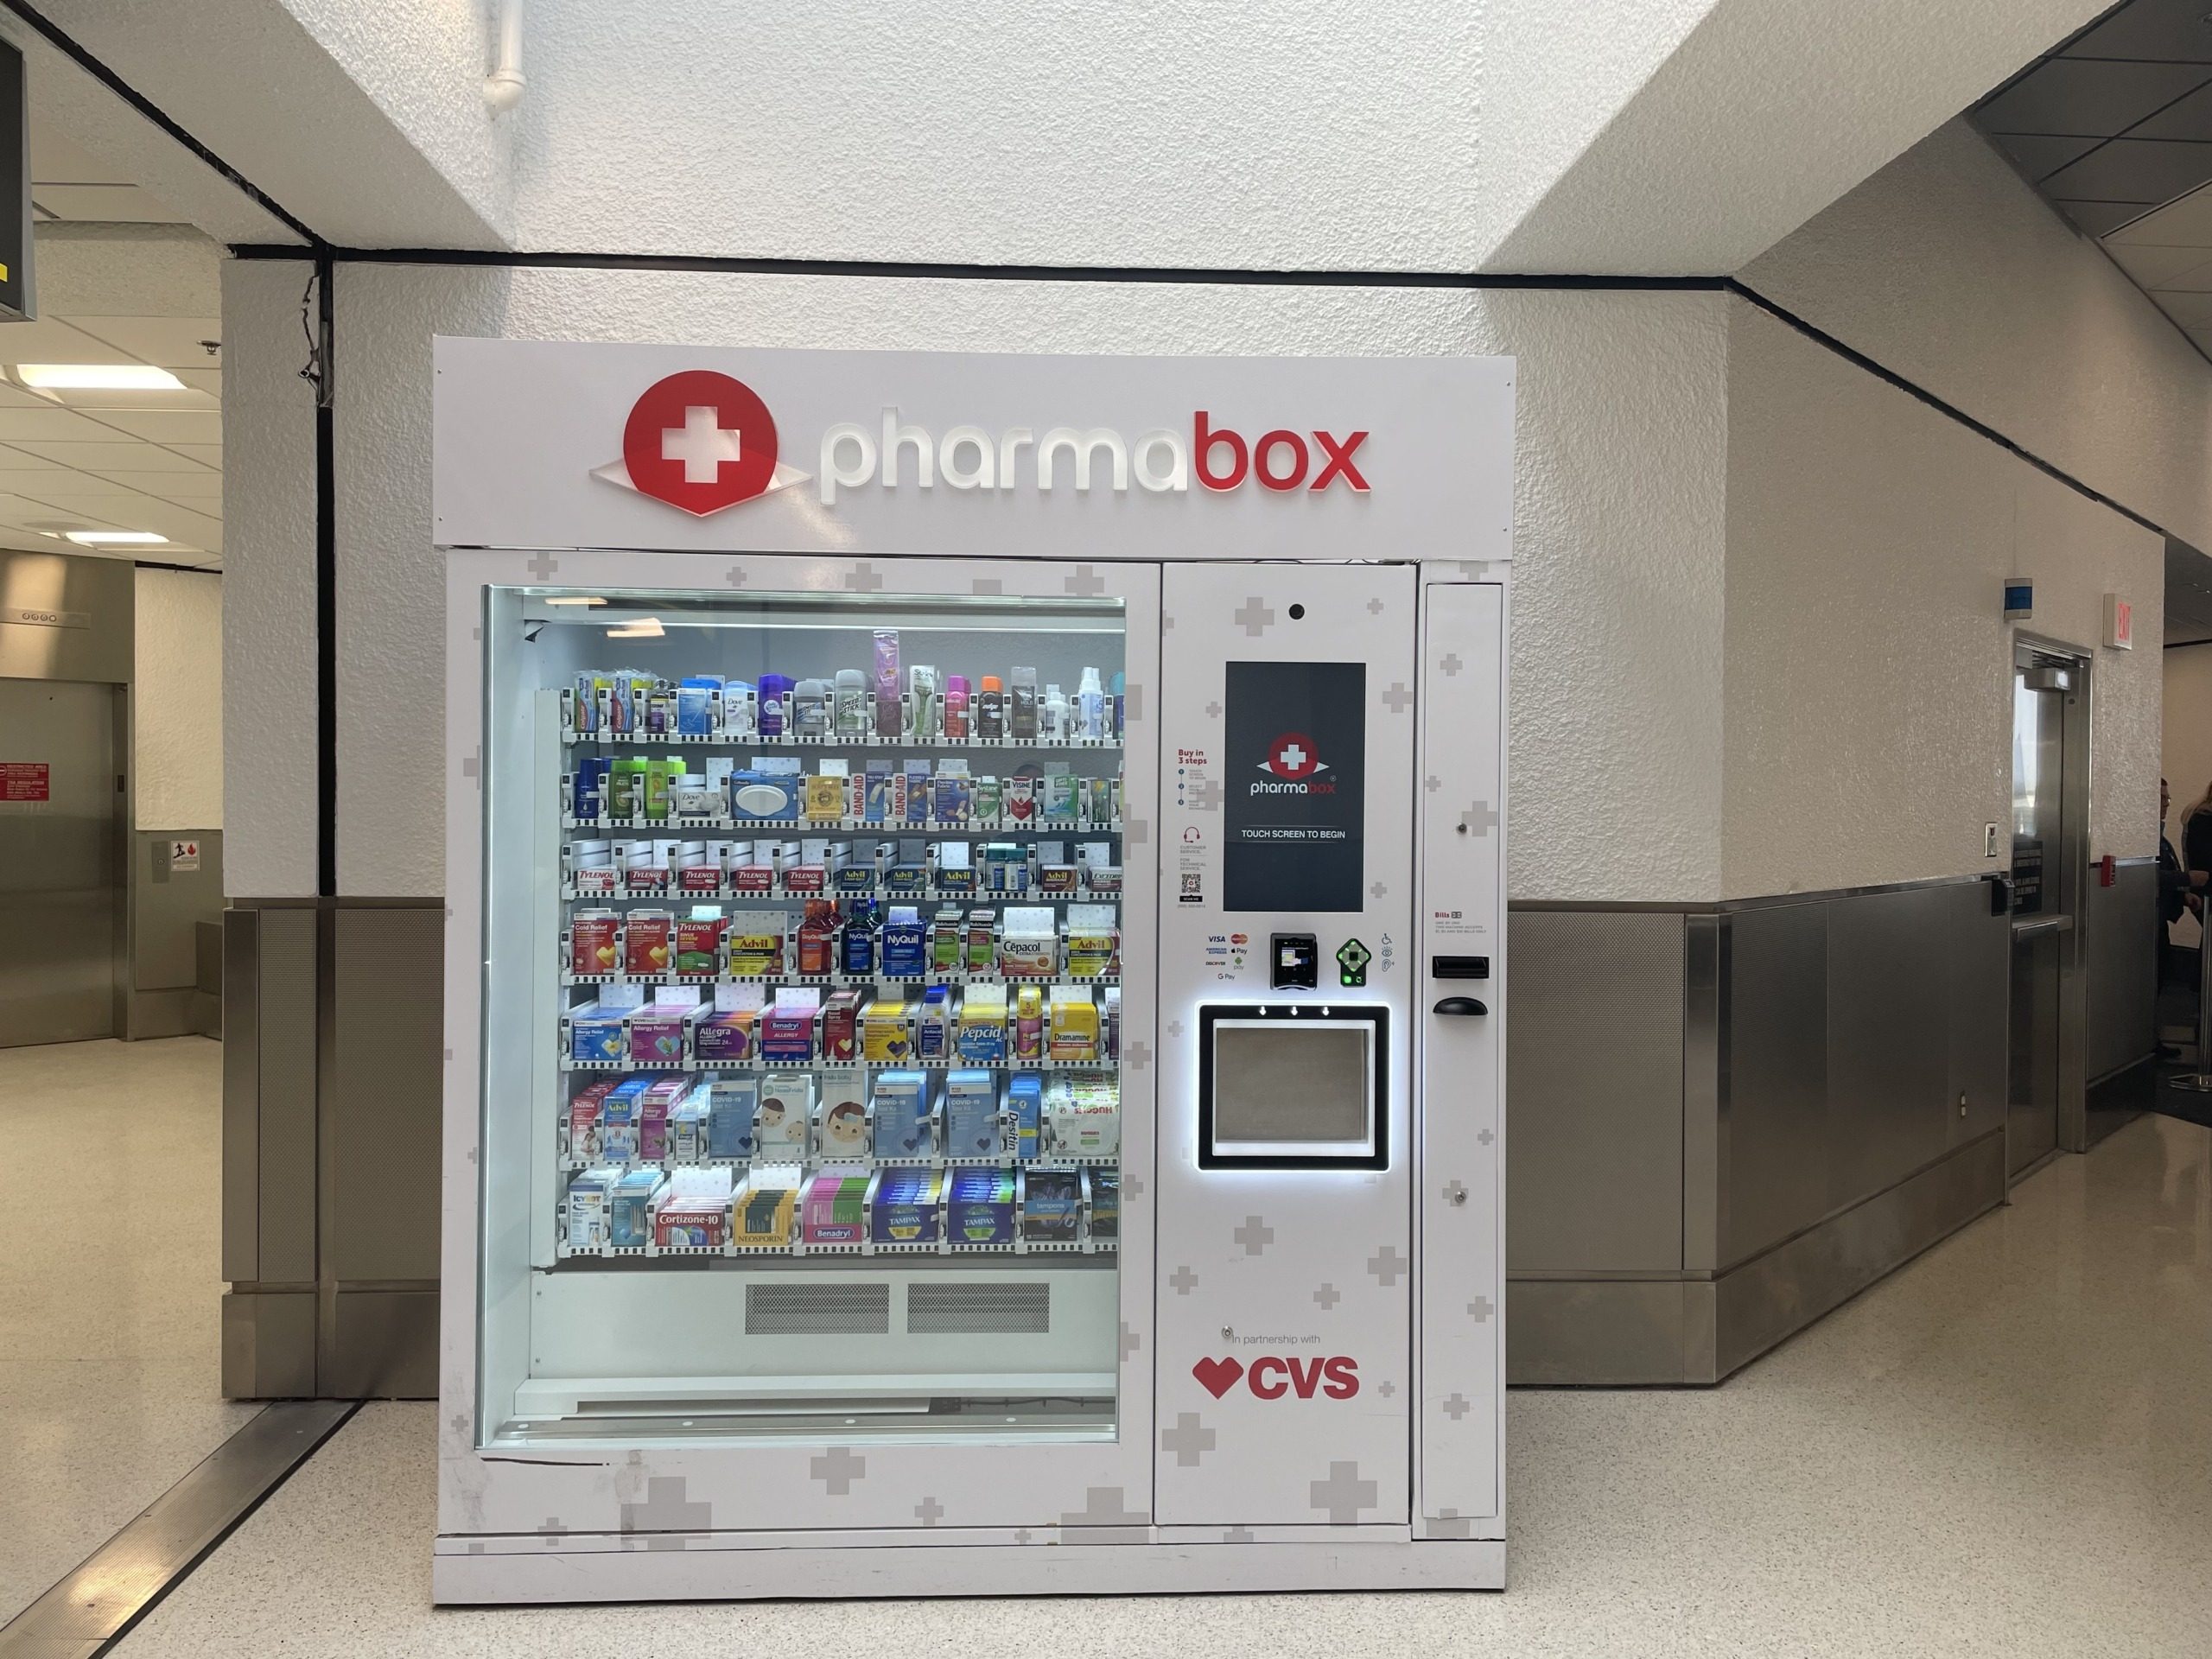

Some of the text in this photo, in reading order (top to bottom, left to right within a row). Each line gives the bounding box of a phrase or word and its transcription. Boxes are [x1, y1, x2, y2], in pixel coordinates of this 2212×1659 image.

[820, 406, 1372, 505] pharmabox
[1250, 780, 1336, 796] pharmabox
[854, 775, 864, 816] BAND-AID
[895, 775, 906, 816] BAND-AID
[1272, 830, 1305, 838] SCREEN
[1320, 830, 1345, 839] BEGIN
[579, 870, 614, 879] TYLENOL
[740, 939, 768, 948] Advil
[887, 934, 919, 946] NyQuil
[1077, 940, 1105, 949] Advil
[700, 1027, 731, 1036] Allegra
[960, 1026, 1002, 1042] Pepcid
[1054, 1033, 1090, 1041] Dramamine
[1008, 1112, 1019, 1151] Desitin
[889, 1216, 921, 1225] TAMPAX
[964, 1217, 995, 1226] TAMPAX
[817, 1230, 850, 1238] Benadryl
[1243, 1335, 1298, 1345] partnership
[1300, 1335, 1320, 1344] with
[1248, 1356, 1359, 1400] CVS
